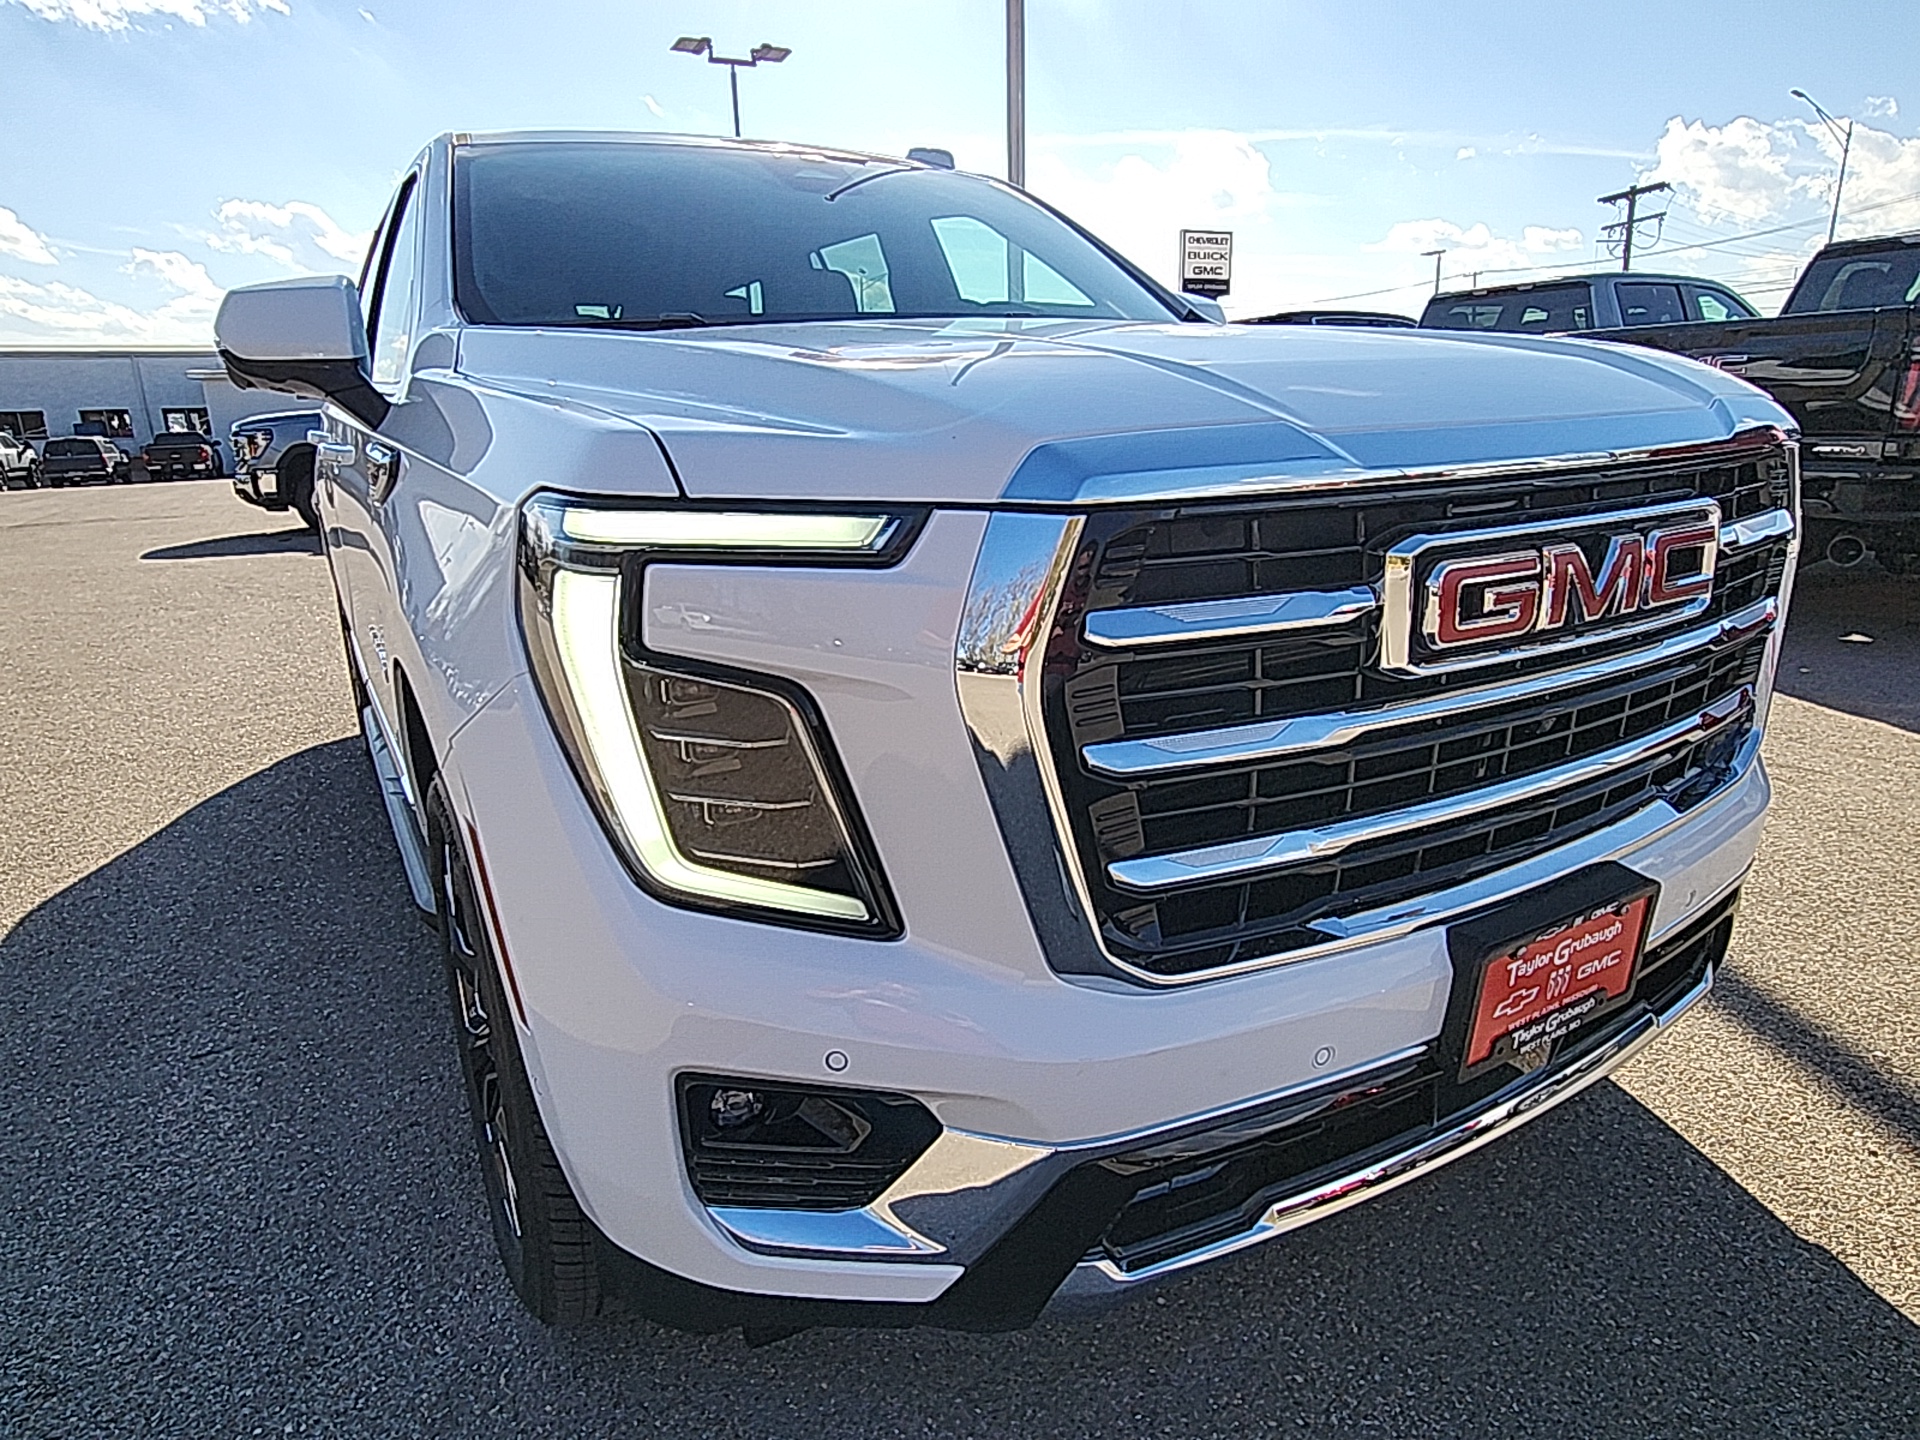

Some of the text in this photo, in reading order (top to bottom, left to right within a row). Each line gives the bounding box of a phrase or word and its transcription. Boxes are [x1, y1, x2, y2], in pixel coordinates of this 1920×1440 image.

[1188, 236, 1229, 246] CHEVROLET
[1188, 251, 1228, 261] BUICK
[1193, 266, 1223, 275] GMC
[1424, 520, 1718, 650] GMC
[1591, 902, 1620, 920] GMC
[1507, 921, 1622, 987] Taylor Grubaugh
[1577, 950, 1622, 980] GMC
